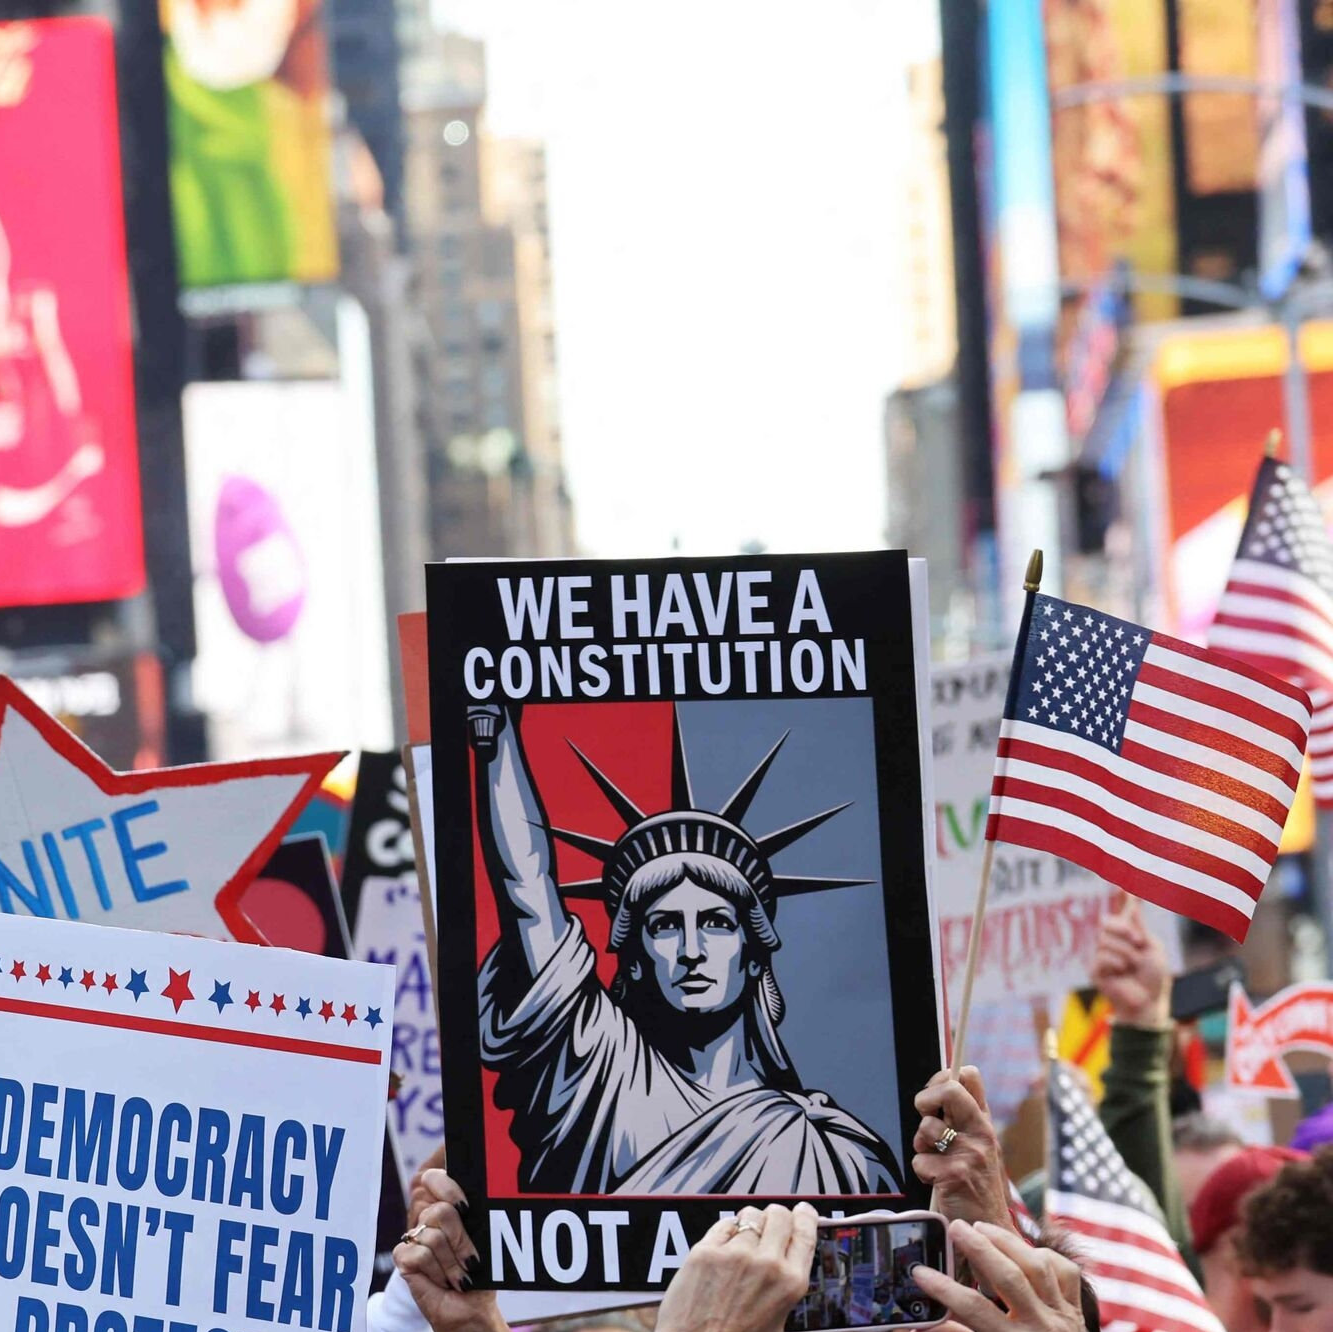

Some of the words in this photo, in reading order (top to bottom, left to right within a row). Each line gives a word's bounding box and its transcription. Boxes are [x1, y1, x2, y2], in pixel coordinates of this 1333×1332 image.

[497, 575, 594, 641] WE
[612, 571, 774, 638] HAVE
[788, 569, 833, 633] A
[463, 638, 867, 700] CONSTITUTION
[488, 1209, 630, 1284] NOT
[646, 1210, 693, 1284] A
